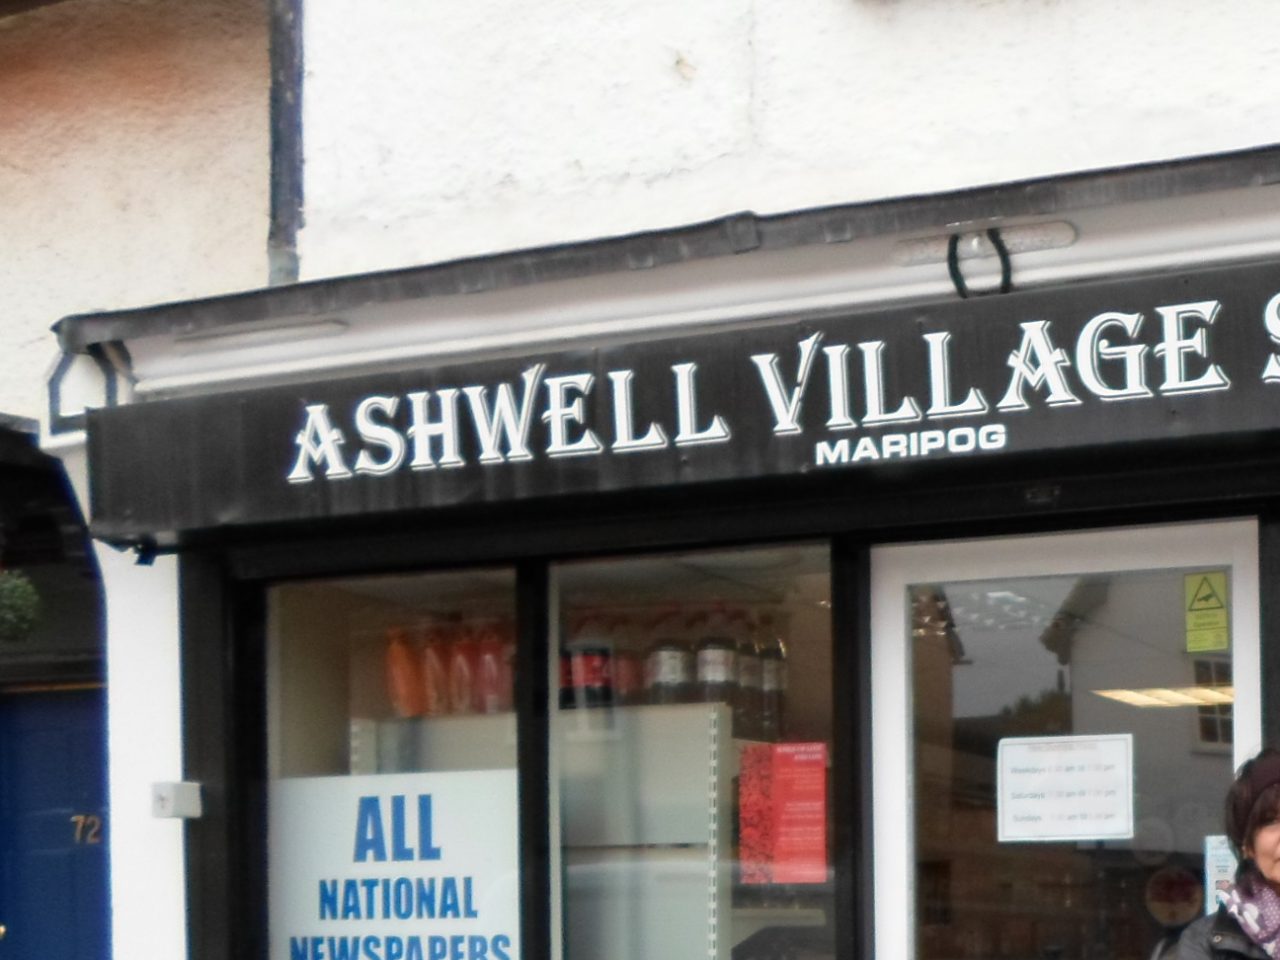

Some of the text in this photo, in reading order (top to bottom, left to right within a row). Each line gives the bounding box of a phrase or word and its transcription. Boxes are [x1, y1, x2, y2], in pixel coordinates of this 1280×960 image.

[286, 362, 730, 482] ASHWELL
[751, 300, 1231, 436] VILLAGE
[815, 423, 1007, 467] MARIPOG
[70, 815, 103, 844] 72
[353, 794, 442, 862] ALL
[319, 876, 479, 920] NATIONAL
